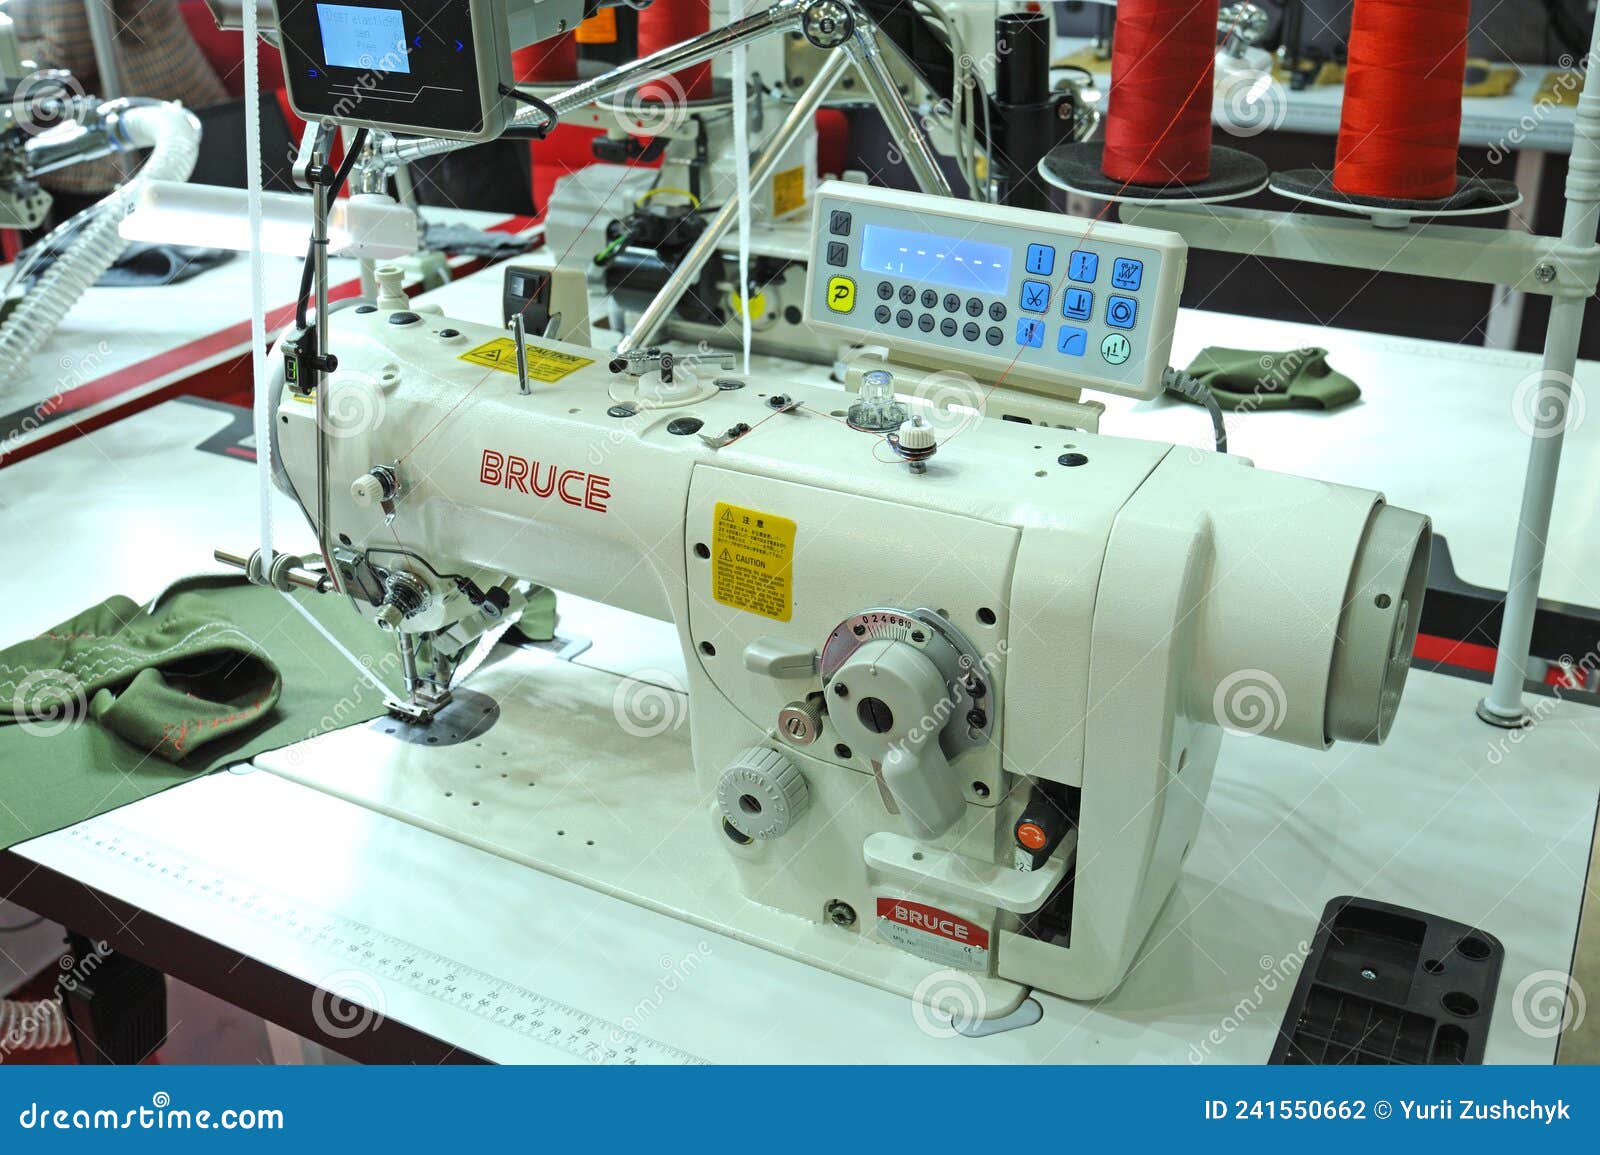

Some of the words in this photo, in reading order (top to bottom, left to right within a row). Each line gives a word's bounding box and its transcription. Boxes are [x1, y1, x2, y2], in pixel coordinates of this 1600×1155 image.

[480, 449, 611, 513] BRUCE
[735, 553, 766, 569] CAUTION
[871, 614, 878, 623] 2
[881, 615, 887, 623] 4
[889, 616, 896, 625] 6
[898, 618, 904, 627] 8
[895, 905, 969, 940] BRUCE
